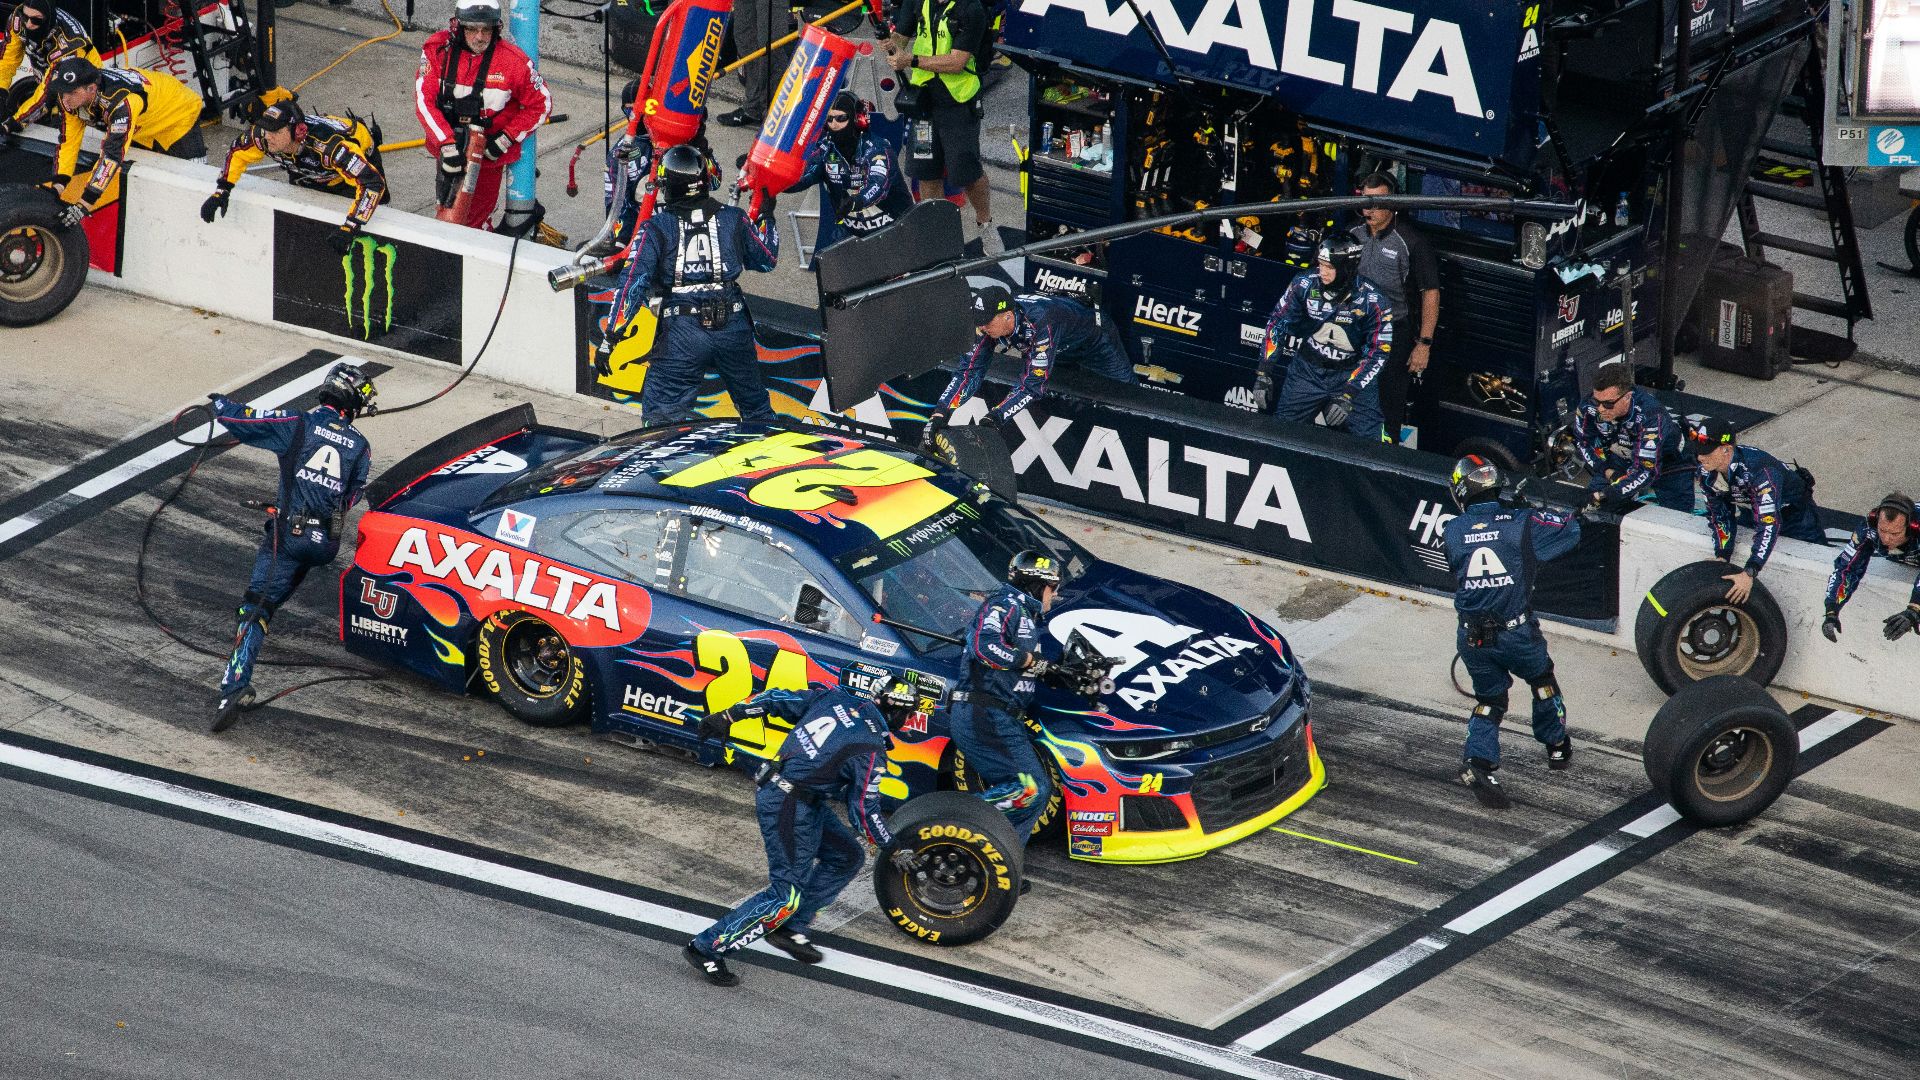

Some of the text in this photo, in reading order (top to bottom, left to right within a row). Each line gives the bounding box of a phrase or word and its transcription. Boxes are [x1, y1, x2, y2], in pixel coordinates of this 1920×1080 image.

[1523, 4, 1540, 28] 24
[691, 23, 722, 105] SUNOCO
[1019, 0, 1484, 118] ALTA
[1517, 47, 1540, 63] AXALTA
[765, 52, 806, 134] SUNOCO
[819, 66, 838, 101] NASCAR
[1840, 130, 1862, 138] P51
[1889, 155, 1917, 164] FPL
[683, 262, 728, 274] AXALA
[1034, 268, 1098, 293] Hendri
[1134, 294, 1202, 331] Hertz
[1606, 300, 1639, 328] Hez
[1552, 319, 1585, 343] LIBERTY
[1552, 331, 1584, 350] UNIVERSITY
[1360, 359, 1386, 388] AXALTA
[1003, 394, 1033, 420] AXALTA
[313, 425, 355, 449] ROBERTS
[1721, 434, 1731, 444] 24
[295, 468, 342, 492] AXALTA
[599, 460, 645, 488] SYSTEMS
[609, 460, 657, 488] COATING
[690, 505, 773, 535] William Byron
[906, 512, 964, 544] MONSTER
[500, 530, 526, 542] Valvoline
[1464, 530, 1500, 544] DICKEY
[1757, 524, 1773, 559] AXALTA
[1035, 557, 1051, 569] 24
[389, 527, 622, 632] AXALTA
[1464, 575, 1514, 590] AXALTA
[360, 576, 399, 619] LU
[351, 614, 408, 639] LIBERTY
[351, 626, 408, 647] UNIVERSITY
[563, 656, 585, 709] EAGLE
[862, 664, 888, 677] NASCAR
[1115, 634, 1260, 711] AXALTA
[893, 683, 908, 694] 24
[623, 684, 690, 720] Hertz
[794, 727, 818, 760] AXALTA
[1138, 772, 1163, 793] 24
[870, 812, 892, 843] AXALTA
[1070, 811, 1116, 821] MOOG
[1073, 823, 1108, 833] Edelbrock
[918, 824, 1011, 891] GOODYEAR
[1072, 842, 1101, 850] SUNOCO
[888, 907, 941, 942] EAGLE
[716, 923, 764, 953] AXALA
